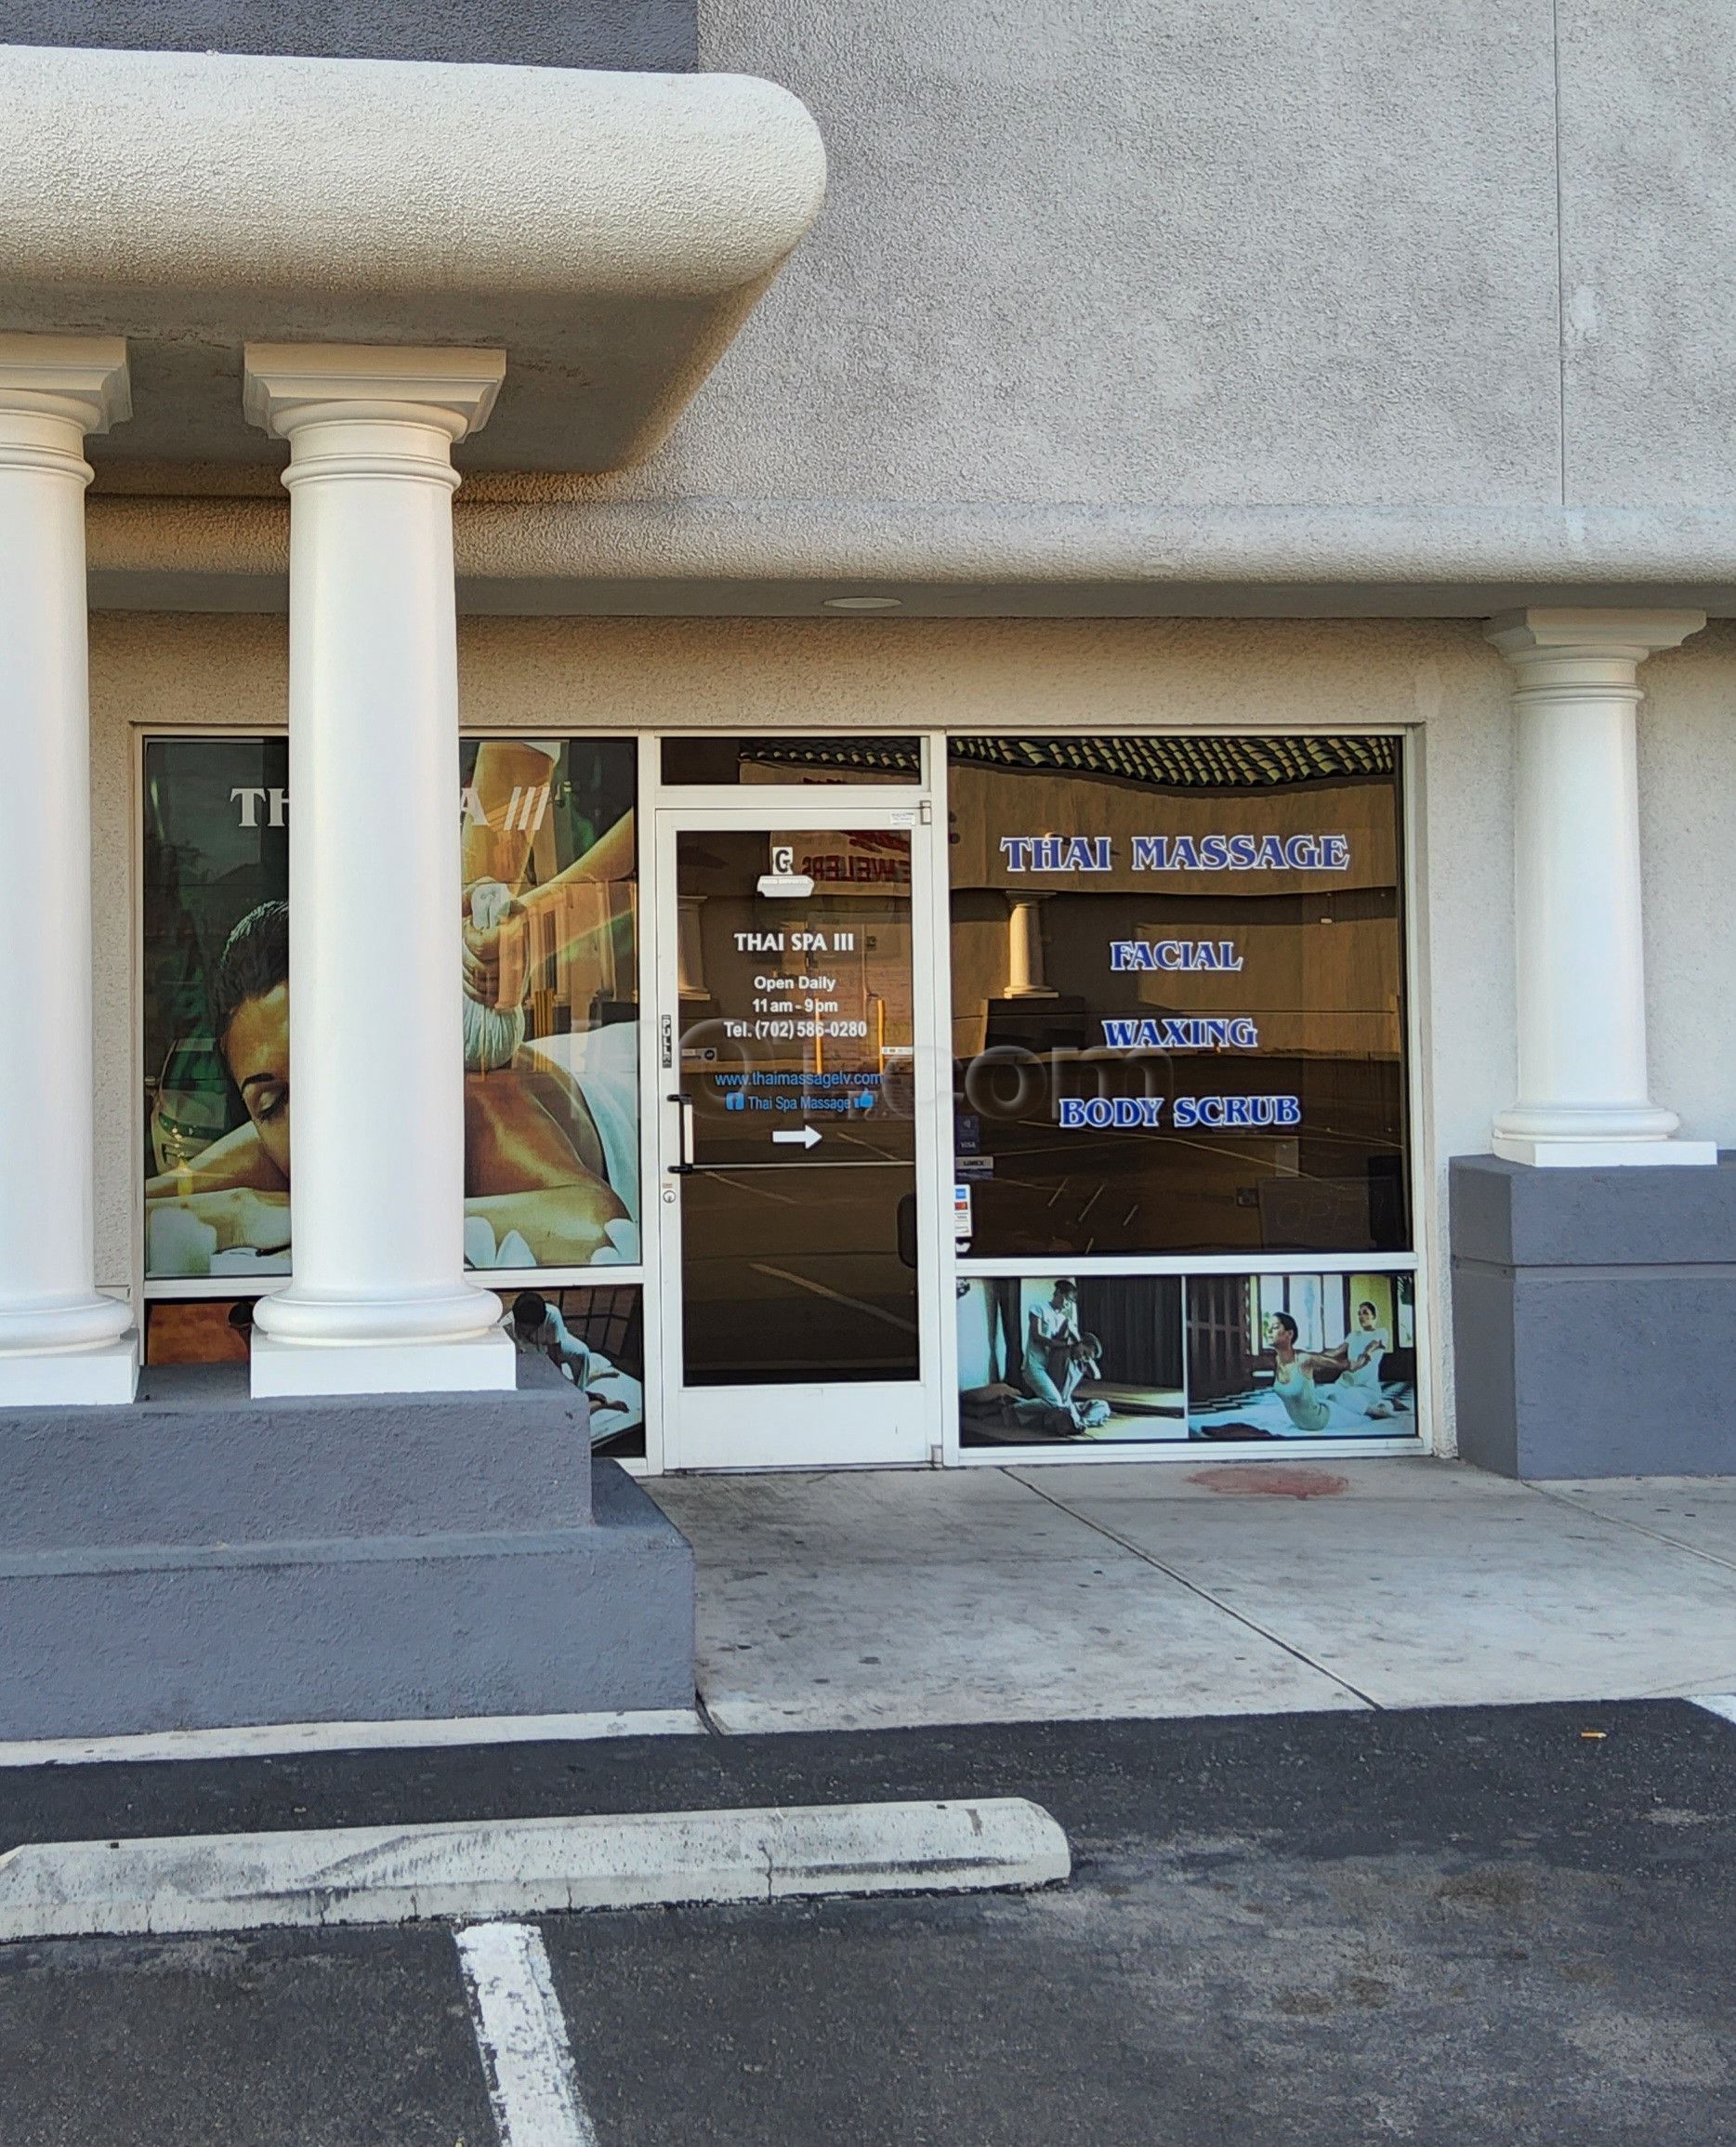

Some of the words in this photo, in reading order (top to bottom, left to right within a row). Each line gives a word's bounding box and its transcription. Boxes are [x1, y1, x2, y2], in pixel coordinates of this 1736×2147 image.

[775, 849, 793, 874] G
[1000, 836, 1112, 872] THAI
[1131, 834, 1350, 871] MASSAGE
[733, 933, 784, 952] THAI
[791, 932, 828, 952] SPA
[834, 933, 854, 951] III
[1110, 940, 1244, 971] FACIAL
[754, 976, 795, 993] Open
[798, 976, 836, 993] Daily
[723, 1021, 752, 1038] Tel.
[755, 1020, 795, 1040] (702)
[796, 1021, 868, 1038] 586-0280
[1101, 1018, 1258, 1049] WAXING
[715, 1071, 883, 1088] www.thaimassagelv.com
[747, 1095, 772, 1110] Thai
[775, 1095, 797, 1113] Spa
[800, 1095, 851, 1113] Massage
[1059, 1098, 1164, 1127] BODY
[1174, 1096, 1300, 1127] SCRUB
